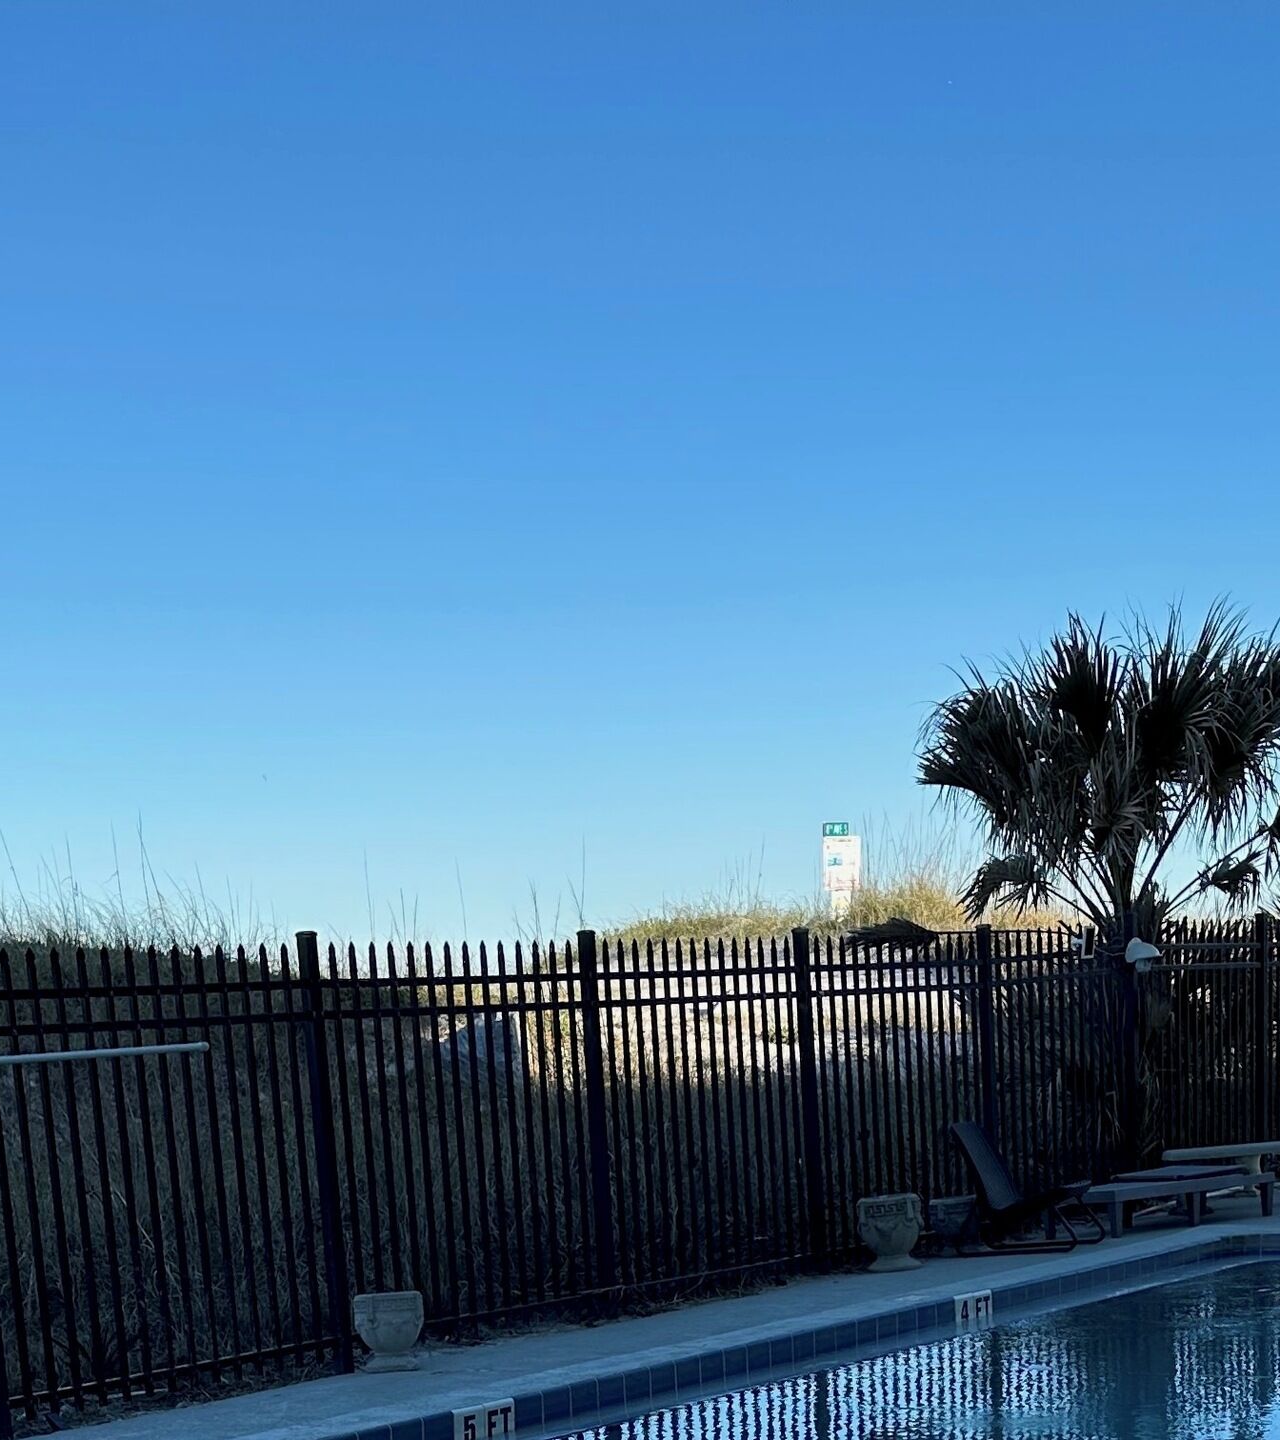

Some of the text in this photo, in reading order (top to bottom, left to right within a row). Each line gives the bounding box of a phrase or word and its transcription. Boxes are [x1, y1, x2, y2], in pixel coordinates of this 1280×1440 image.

[961, 1295, 991, 1320] 4 FT
[487, 1406, 512, 1437] FT
